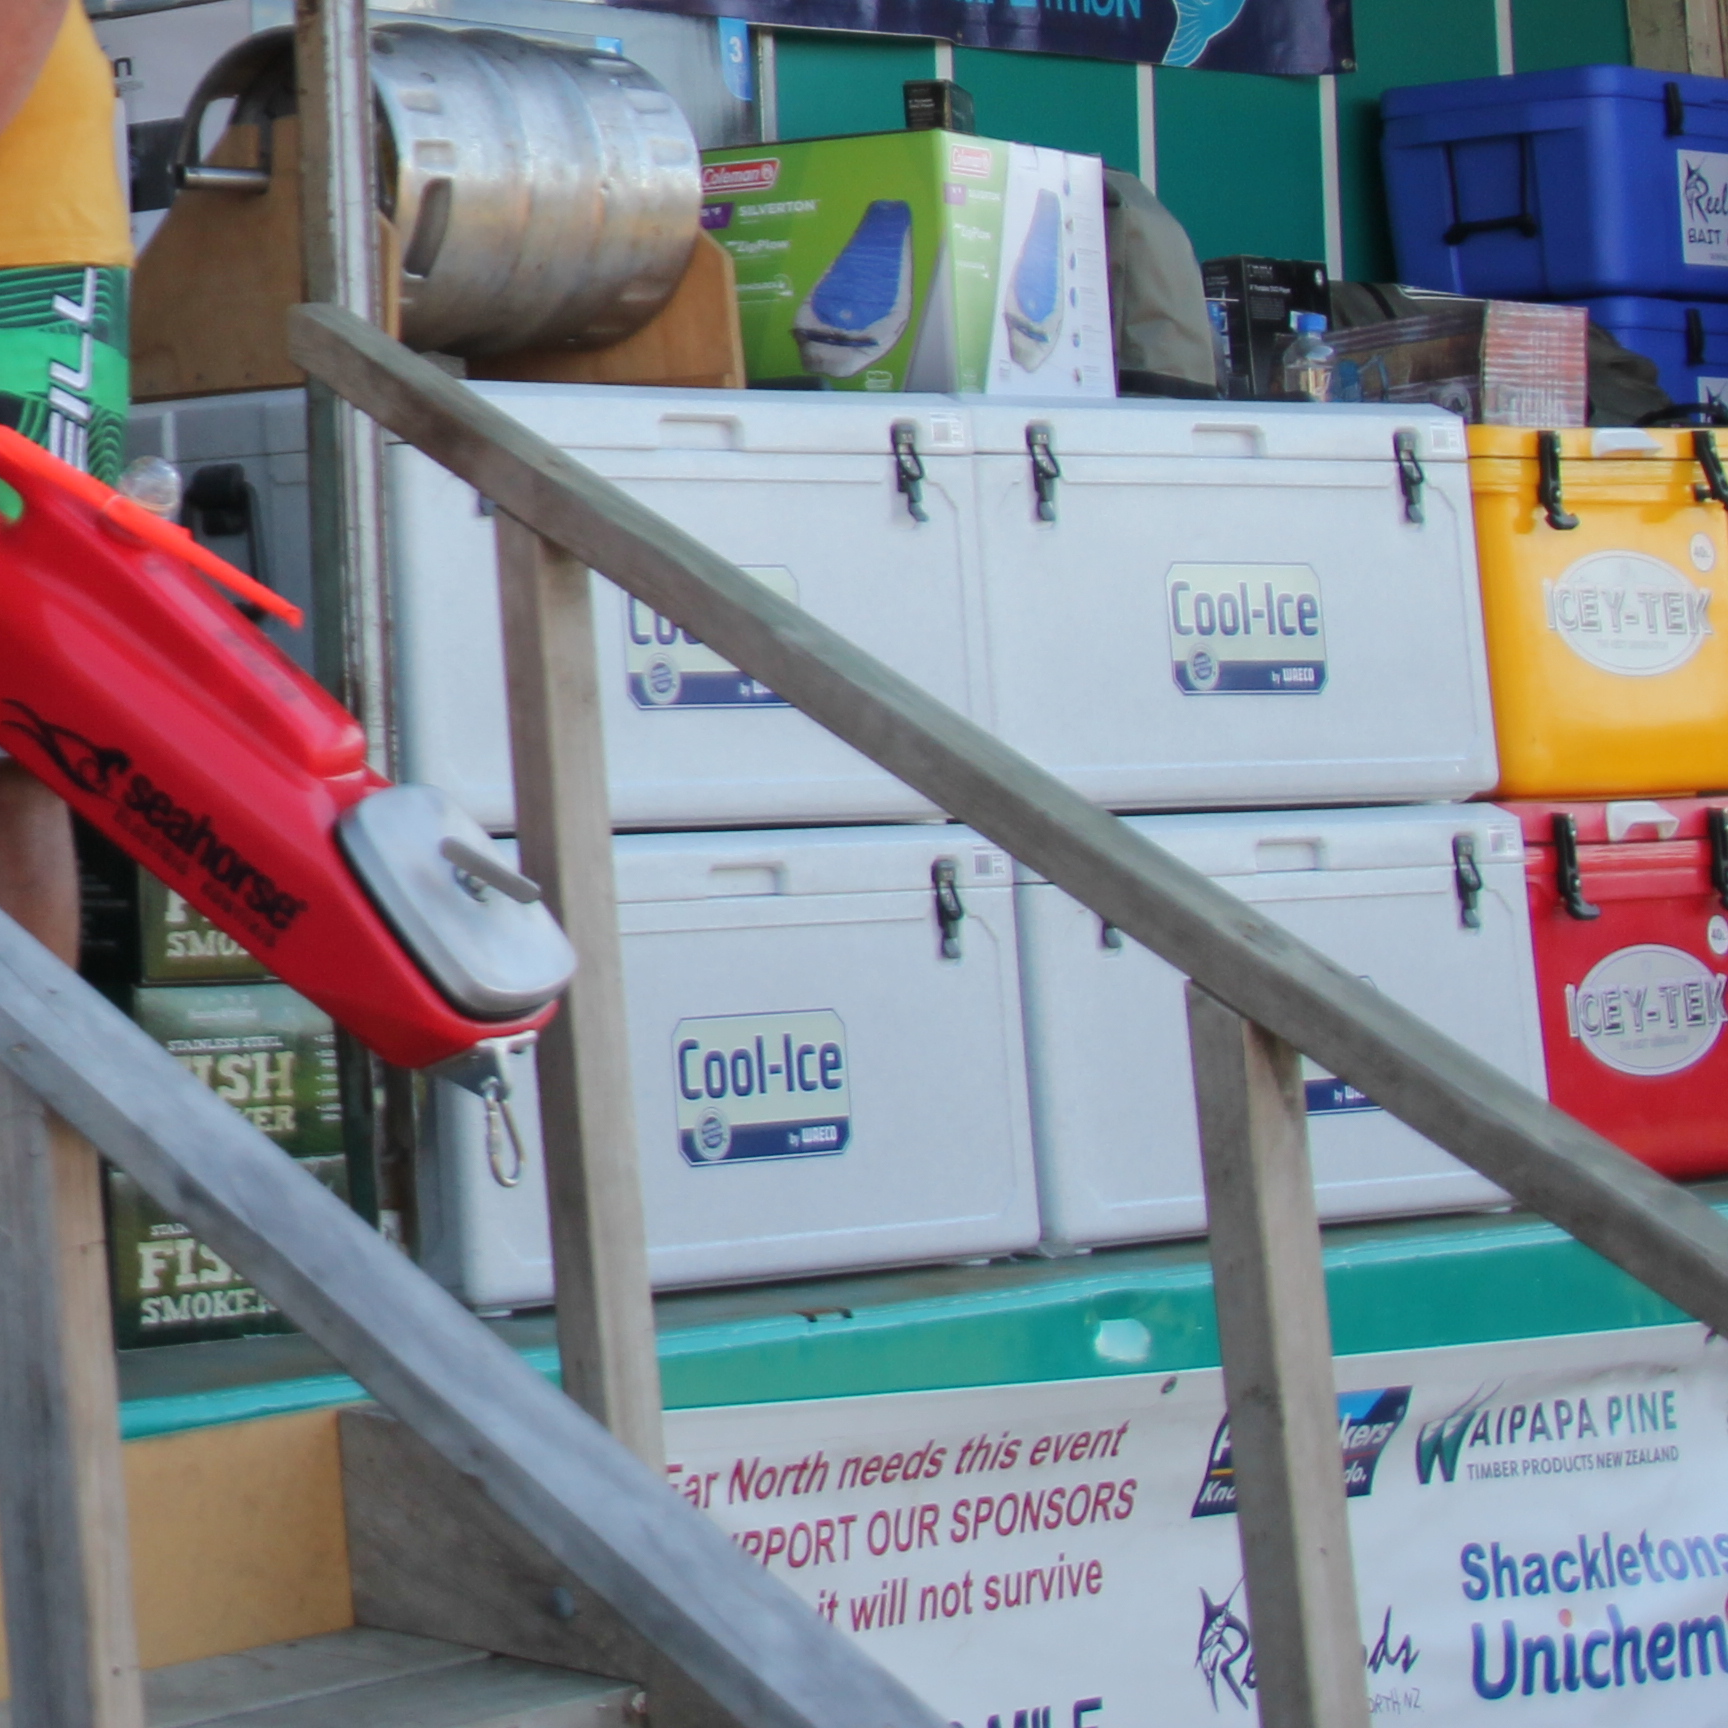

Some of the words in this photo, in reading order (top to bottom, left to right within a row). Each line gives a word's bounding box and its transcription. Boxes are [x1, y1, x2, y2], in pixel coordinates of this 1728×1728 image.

[729, 35, 742, 62] 3
[738, 199, 817, 218] SILVERTON
[1688, 228, 1722, 245] BAIT
[1170, 580, 1319, 636] Cool-Ice
[1543, 579, 1714, 635] ICEY-TEK
[124, 775, 289, 930] seahorse
[1564, 973, 1728, 1038] ICEY-TEK
[167, 1037, 240, 1052] STAINLESS
[241, 1035, 284, 1049] STEEL
[678, 1033, 843, 1101] Cool-Ice
[1608, 1390, 1678, 1436] PINE
[728, 1451, 831, 1505] North
[838, 1439, 948, 1490] needs
[954, 1430, 1024, 1476] this
[1029, 1420, 1131, 1467] event
[1467, 1461, 1519, 1481] TIMBER
[1522, 1453, 1595, 1477] PRODUCTS
[1596, 1450, 1623, 1469] NEW
[1625, 1445, 1680, 1467] ZEALAND
[867, 1503, 940, 1558] OUR
[950, 1478, 1138, 1545] SPONSORS
[850, 1577, 910, 1633] will
[919, 1570, 974, 1623] not
[984, 1553, 1104, 1612] survive
